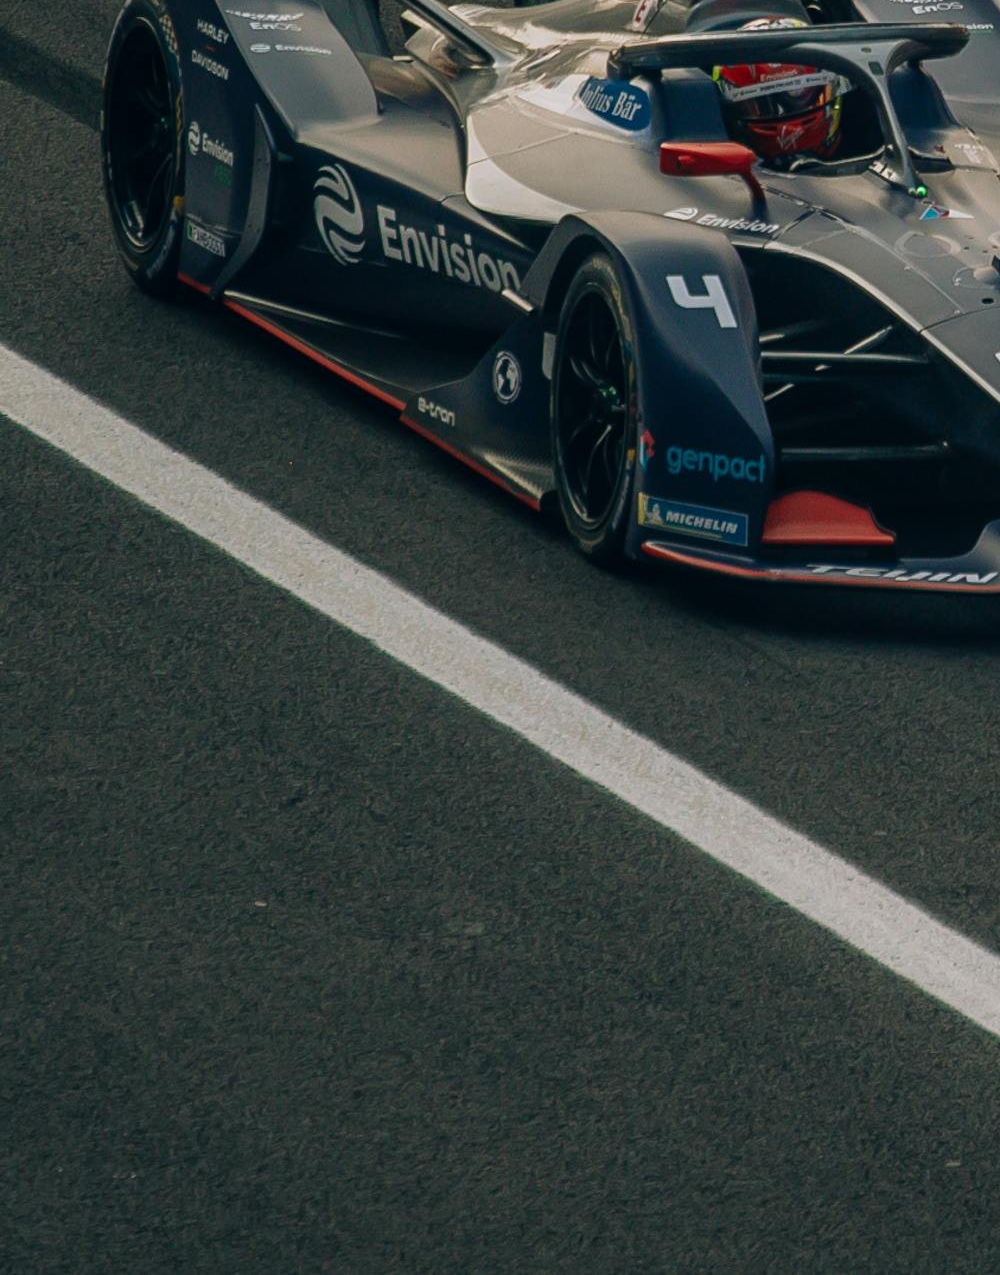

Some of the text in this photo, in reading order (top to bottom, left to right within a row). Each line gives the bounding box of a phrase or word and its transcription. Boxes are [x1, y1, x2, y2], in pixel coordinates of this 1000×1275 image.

[911, 1, 963, 15] EnOS
[197, 18, 230, 45] HARLEY
[965, 22, 994, 30] sion
[191, 49, 230, 81] DAVIDSON
[611, 90, 643, 122] Bär
[201, 131, 234, 167] Envision
[695, 213, 780, 234] Envision
[376, 204, 521, 294] Envision
[666, 274, 738, 328] 4
[666, 445, 766, 483] genpact
[665, 509, 739, 535] MICHELIN
[806, 563, 998, 584] TEIJIN
